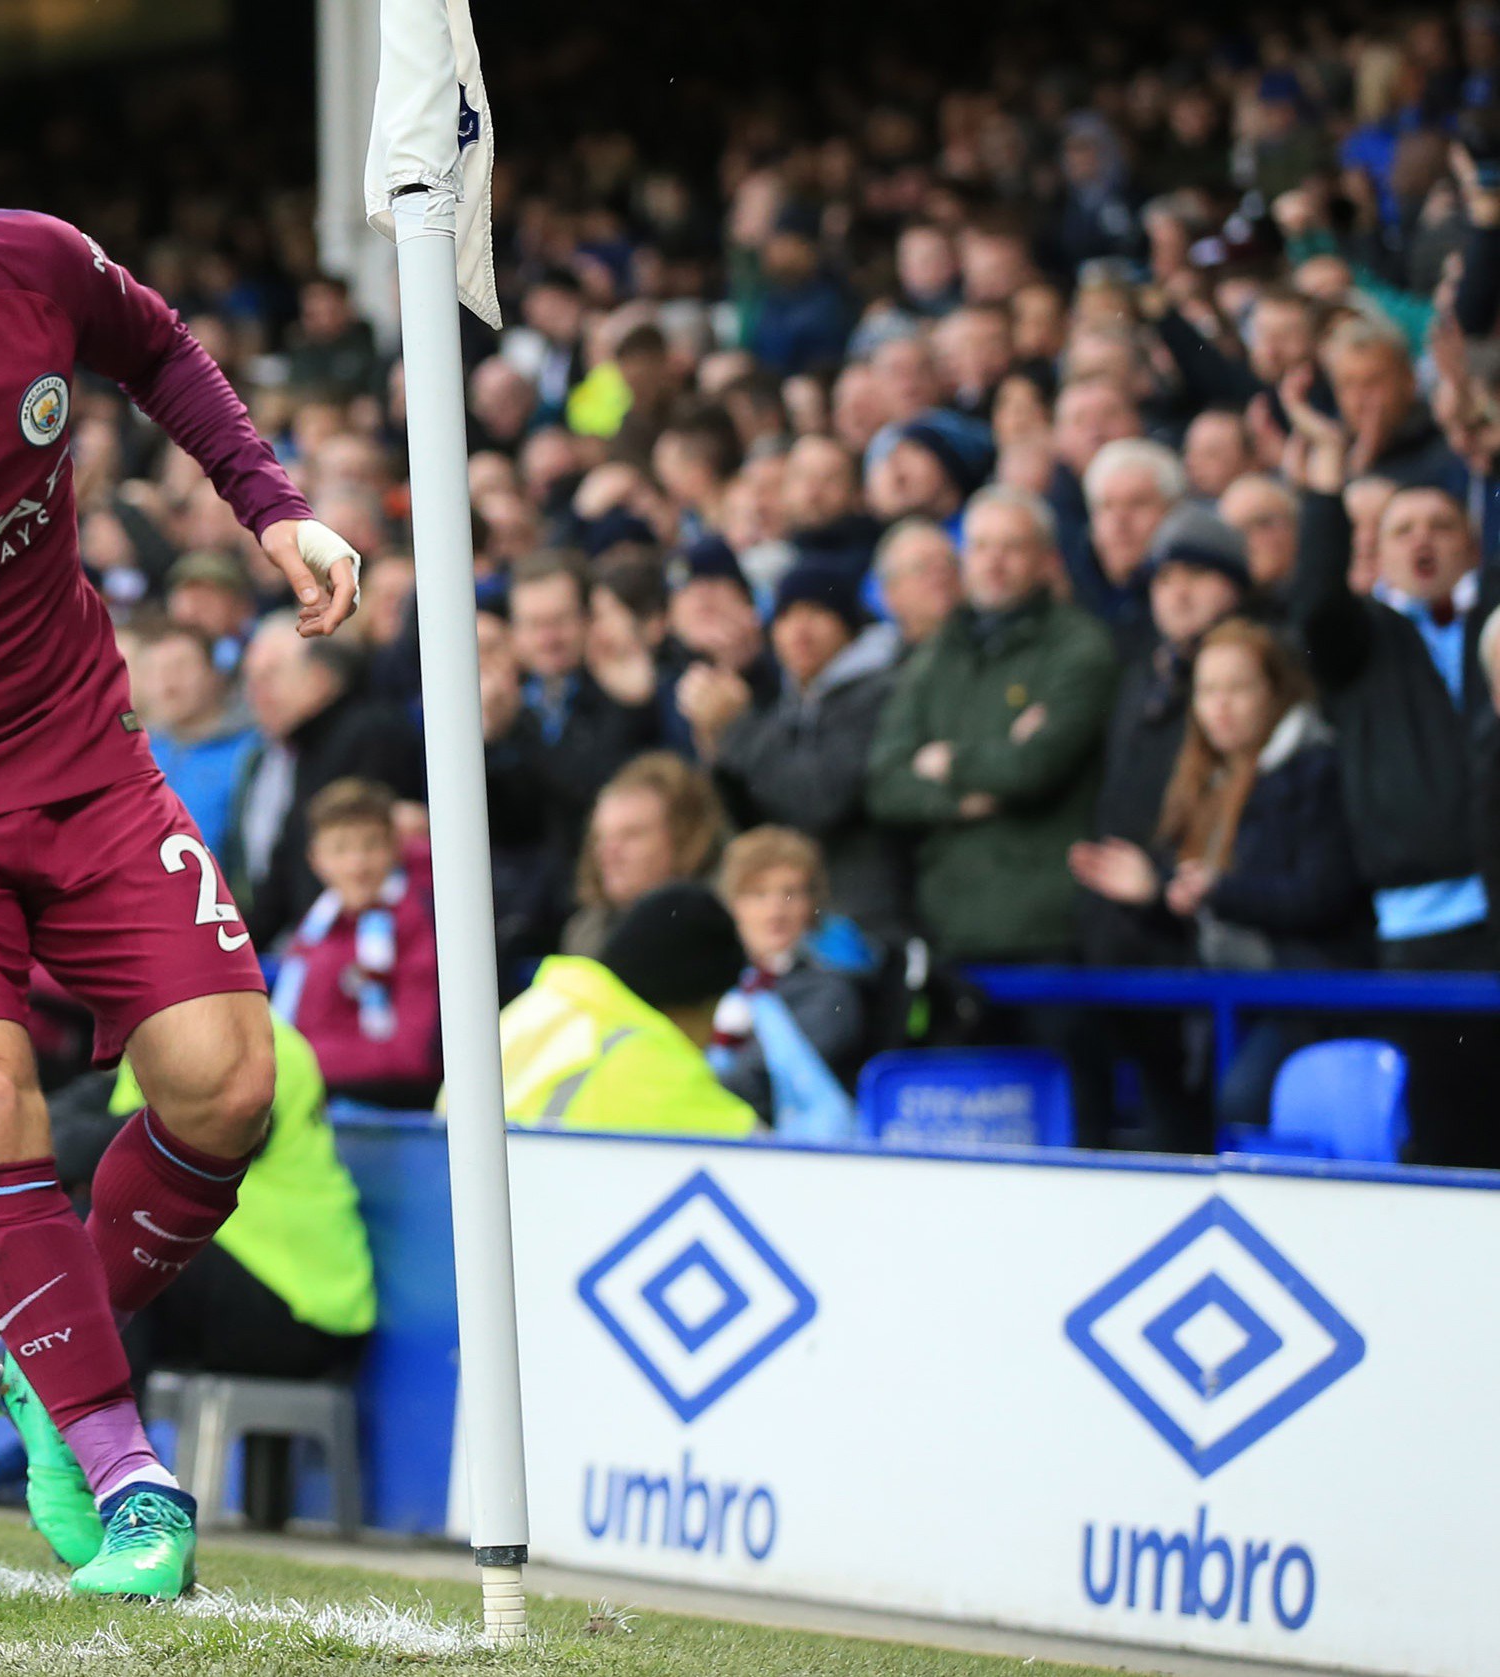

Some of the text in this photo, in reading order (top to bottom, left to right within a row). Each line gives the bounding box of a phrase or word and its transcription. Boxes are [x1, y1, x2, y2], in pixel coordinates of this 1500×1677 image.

[19, 1327, 73, 1357] CITY
[584, 1446, 777, 1561] umbro
[1082, 1502, 1316, 1631] umbro
